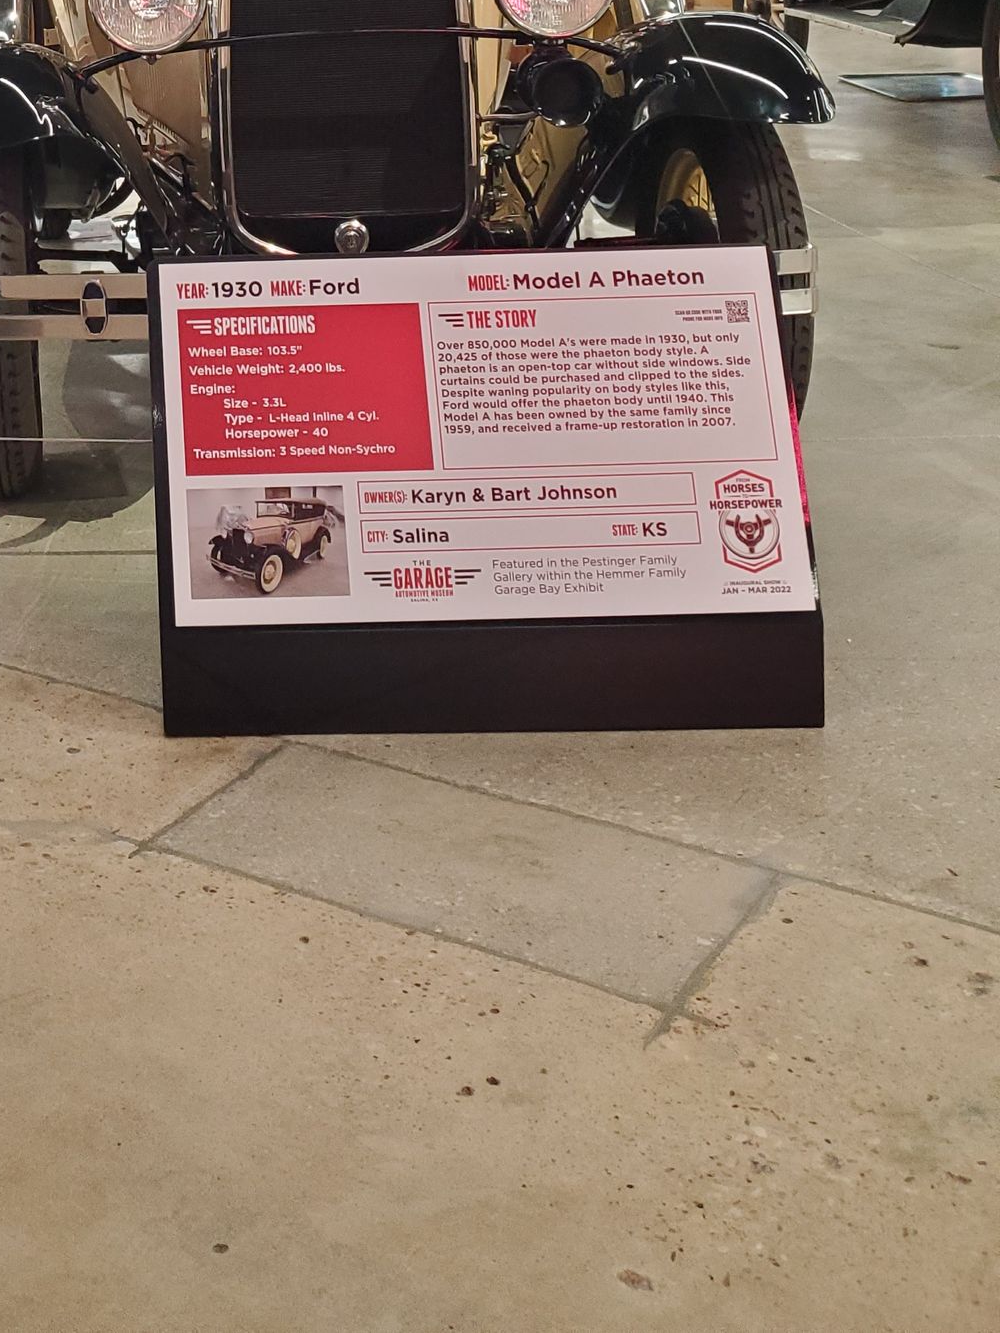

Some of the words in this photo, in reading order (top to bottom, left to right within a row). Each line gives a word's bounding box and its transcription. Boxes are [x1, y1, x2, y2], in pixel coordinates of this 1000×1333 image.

[468, 275, 510, 291] MODEL:
[513, 272, 580, 290] Model
[589, 271, 605, 287] A
[613, 269, 704, 287] Phaeton
[177, 283, 208, 299] YEAR:
[212, 281, 262, 298] 1930
[270, 280, 305, 296] MAKE:
[309, 278, 360, 295] Ford
[214, 315, 315, 336] SPECIFICATIONS
[467, 310, 492, 329] THE
[495, 310, 537, 328] STORY
[437, 341, 463, 350] Over
[468, 340, 516, 350] 850,000
[521, 338, 554, 348] Model
[559, 338, 575, 347] A's
[611, 336, 641, 345] made
[646, 335, 655, 344] in
[659, 335, 689, 344] 1930,
[693, 334, 712, 342] but
[716, 333, 739, 343] only
[188, 347, 226, 357] Wheel
[231, 347, 262, 356] Base:
[438, 353, 477, 363] 20,425
[481, 352, 492, 360] of
[496, 351, 526, 360] those
[562, 350, 579, 358] the
[584, 349, 630, 359] phaeton
[634, 348, 662, 357] body
[667, 346, 697, 356] style.
[701, 346, 709, 354] A
[189, 365, 232, 376] Vehicle
[237, 364, 284, 376] Weight:
[289, 364, 322, 374] 2,400
[325, 363, 345, 373] lbs.
[440, 365, 485, 375] phaeton
[489, 364, 497, 372] is
[502, 364, 514, 372] an
[519, 363, 570, 373] open-top
[596, 360, 638, 369] without
[643, 359, 665, 367] side
[669, 358, 723, 366] windows.
[726, 356, 750, 365] Side
[441, 376, 485, 385] curtains
[489, 375, 520, 384] could
[524, 375, 537, 383] be
[542, 373, 600, 384] purchased
[604, 372, 624, 380] and
[629, 371, 670, 381] clipped
[674, 371, 686, 379] to
[690, 370, 708, 378] the
[712, 369, 744, 377] sides.
[190, 384, 235, 395] Engine:
[442, 388, 484, 399] Despite
[488, 387, 529, 397] waning
[533, 385, 591, 396] popularity
[613, 383, 641, 394] body
[645, 382, 678, 392] styles
[682, 382, 701, 390] like
[705, 381, 729, 391] this,
[224, 398, 248, 408] Size
[263, 398, 286, 407] 3.3L
[443, 400, 469, 409] Ford
[473, 399, 507, 408] would
[511, 399, 538, 407] offer
[542, 398, 560, 407] the
[564, 396, 610, 407] phaeton
[614, 395, 643, 406] body
[647, 394, 671, 404] until
[676, 394, 707, 403] 1940.
[710, 393, 734, 401] This
[225, 413, 253, 425] Type
[269, 413, 309, 423] L-Head
[313, 412, 343, 422] Inline
[347, 411, 354, 421] 4
[358, 411, 379, 422] Cyl.
[444, 412, 477, 421] Model
[482, 412, 490, 421] A
[494, 411, 513, 420] has
[517, 410, 544, 419] been
[548, 409, 586, 419] owned
[590, 409, 604, 419] by
[608, 408, 626, 417] the
[630, 408, 659, 416] same
[663, 406, 697, 416] family
[702, 406, 730, 414] since
[225, 428, 299, 440] Horsepower
[313, 427, 328, 437] 40
[445, 425, 474, 435] 1959,
[478, 424, 498, 433] and
[503, 423, 551, 432] received
[555, 423, 561, 431] a
[565, 422, 617, 431] frame-up
[621, 419, 684, 429] restoration
[688, 418, 698, 427] in
[702, 418, 735, 426] 2007.
[193, 447, 275, 459] Transmission:
[280, 447, 286, 456] 3
[290, 445, 325, 457] Speed
[329, 444, 395, 455] Non-Sychro
[364, 489, 407, 504] OWNER(S):
[411, 488, 465, 505] Karyn
[473, 488, 484, 502] &
[491, 486, 531, 502] Bart
[538, 485, 617, 500] Johnson
[723, 484, 764, 493] HORSES
[710, 499, 782, 510] HORSEPOWER
[367, 530, 388, 543] CITY:
[393, 528, 449, 543] Salina
[612, 524, 638, 537] STATE:
[642, 522, 667, 537] KS
[492, 559, 543, 569] Featured
[547, 558, 556, 567] in
[561, 558, 578, 567] the
[583, 556, 636, 567] Pestinger
[640, 555, 677, 566] Family
[393, 567, 453, 589] GARAGE
[494, 572, 532, 582] Gallery
[537, 571, 571, 580] within
[575, 570, 593, 580] the
[597, 569, 644, 579] Hemmer
[649, 567, 686, 579] Family
[395, 590, 429, 598] AUTOMOTIVE
[431, 589, 453, 597] MUSEUM
[495, 585, 535, 595] Garage
[539, 584, 560, 594] Bay
[565, 582, 604, 593] Exhibit
